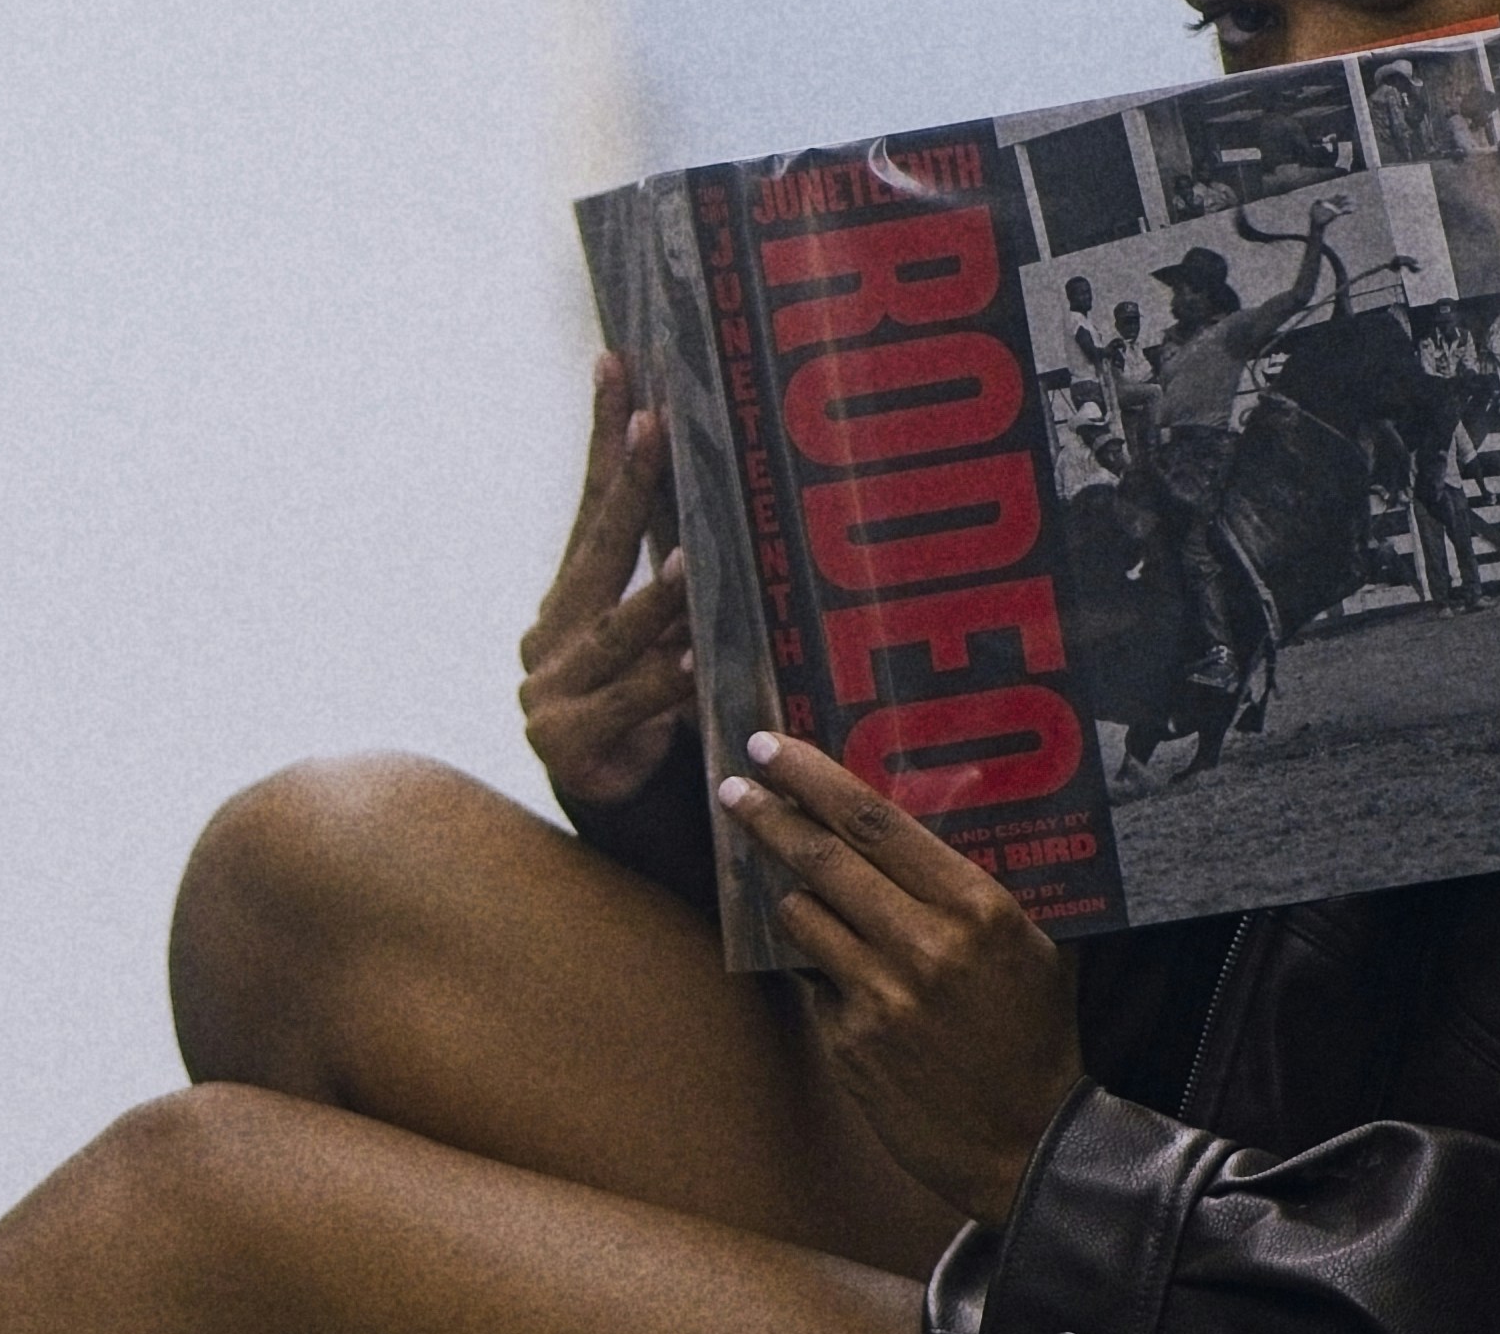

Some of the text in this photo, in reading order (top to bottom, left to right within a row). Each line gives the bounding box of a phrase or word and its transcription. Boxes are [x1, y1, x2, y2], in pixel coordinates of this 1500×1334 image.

[711, 227, 804, 666] JUNETEENTH
[760, 204, 1083, 816] RODEO
[995, 817, 1058, 838] ESSAY
[1064, 811, 1091, 827] BY
[1004, 832, 1097, 871] BIRD
[1040, 882, 1067, 898] BY
